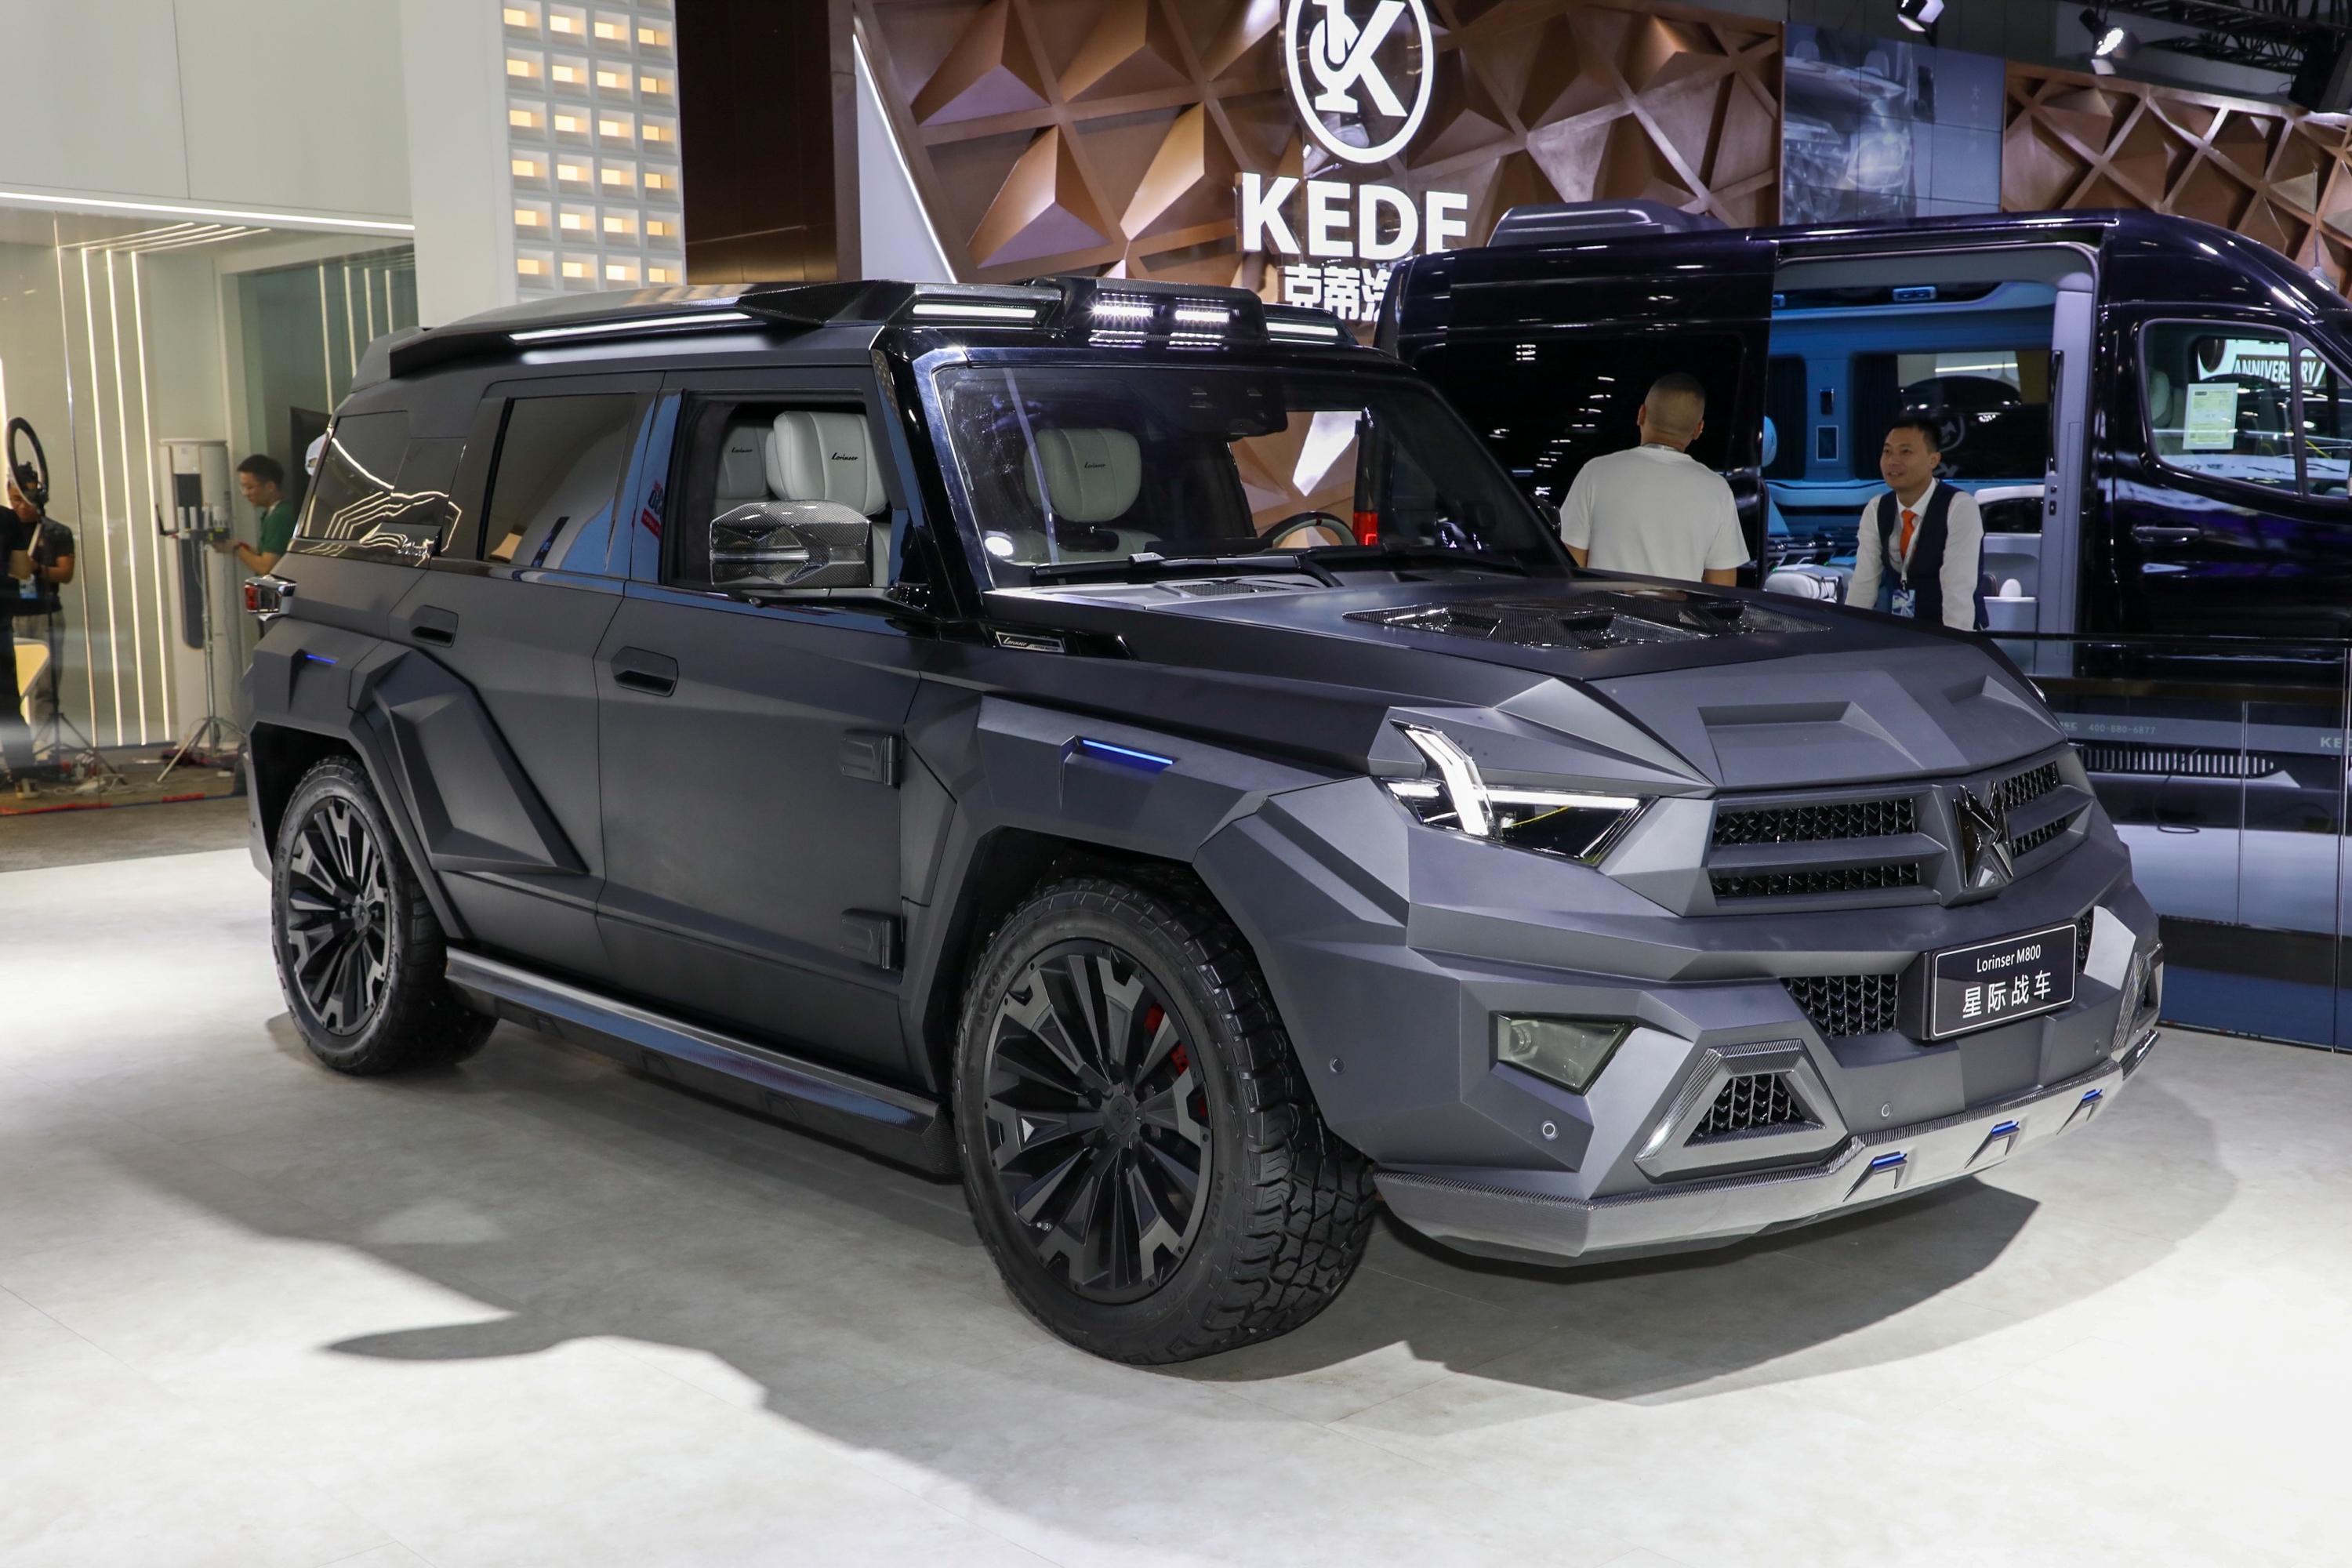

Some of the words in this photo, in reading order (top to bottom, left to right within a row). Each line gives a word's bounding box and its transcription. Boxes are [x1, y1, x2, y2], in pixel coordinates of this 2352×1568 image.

[1242, 172, 1468, 260] KEDE
[2234, 359, 2317, 384] ANNIVERSRY
[1976, 953, 2014, 973] Lorinser
[2016, 944, 2042, 964] M800
[1962, 970, 2052, 1018] 星际战车
